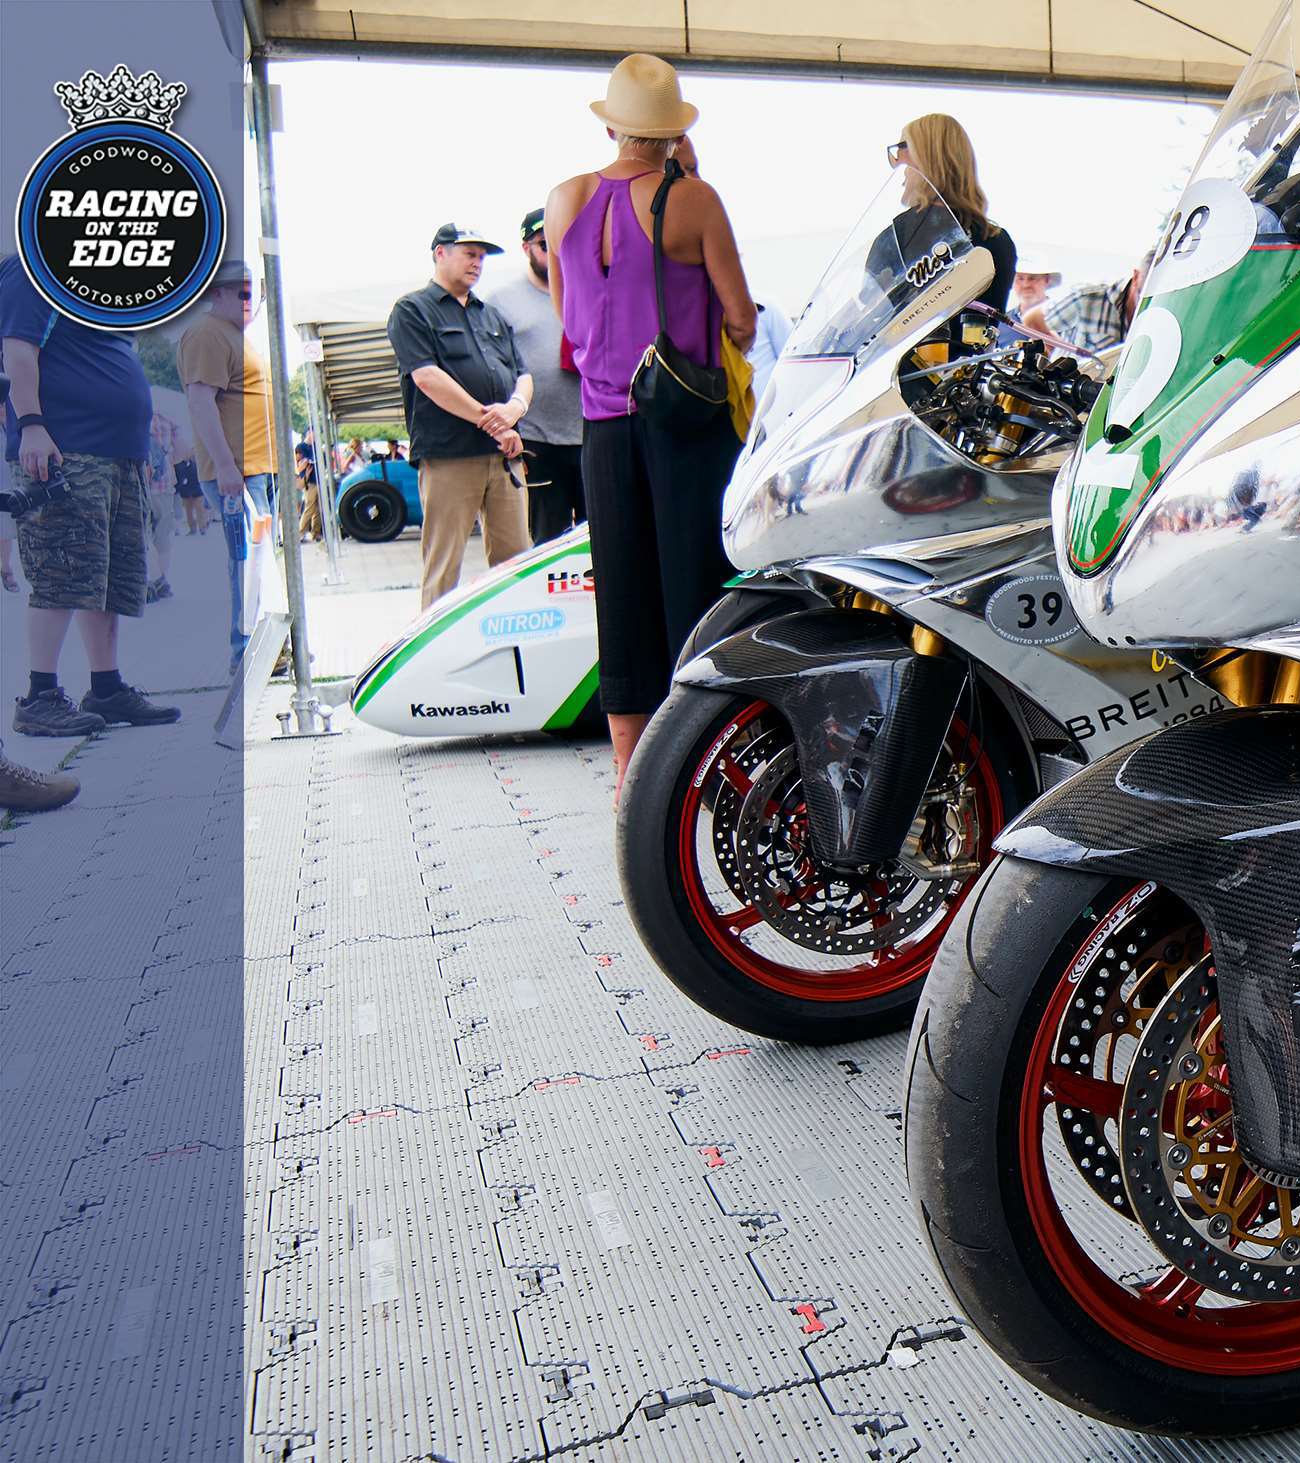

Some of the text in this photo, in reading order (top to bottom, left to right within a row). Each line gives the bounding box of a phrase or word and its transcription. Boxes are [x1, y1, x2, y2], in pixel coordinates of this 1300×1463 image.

[902, 286, 952, 325] BREITLING
[487, 611, 556, 635] NITRON
[1017, 592, 1063, 629] 39
[410, 701, 510, 718] Kawasaki
[1078, 914, 1120, 967] RACING
